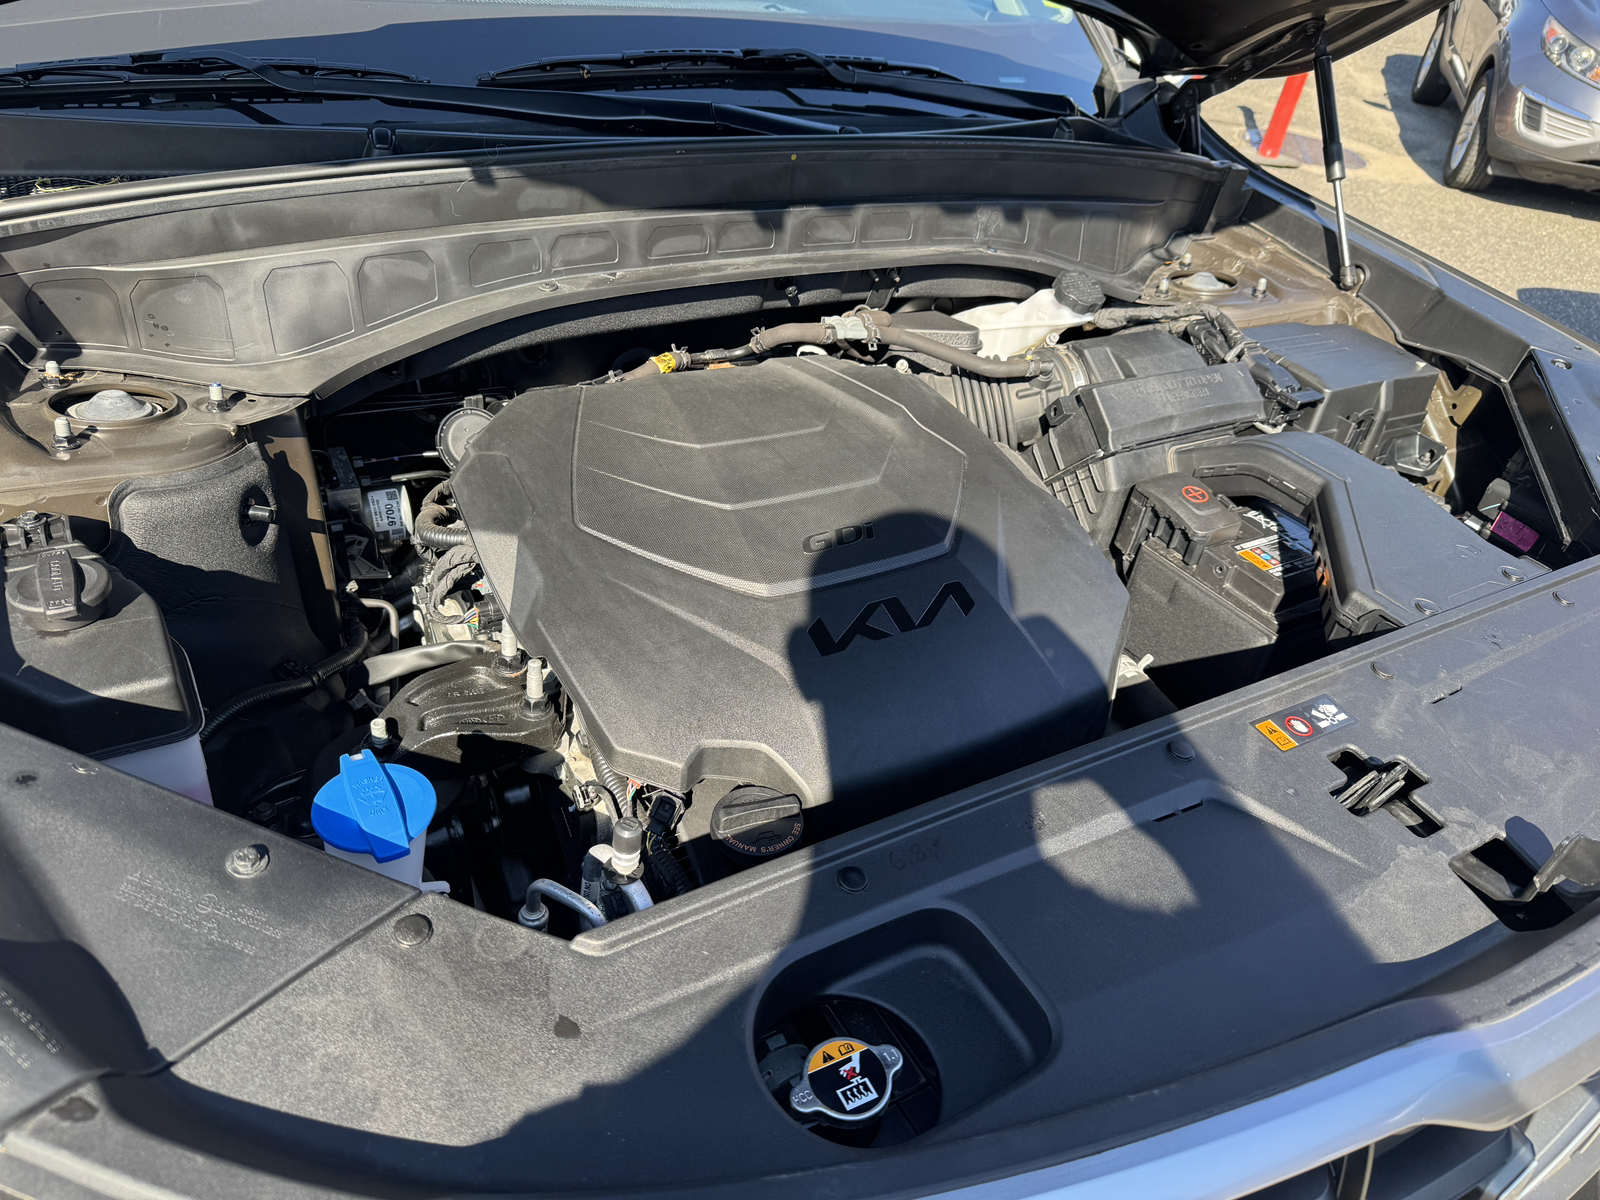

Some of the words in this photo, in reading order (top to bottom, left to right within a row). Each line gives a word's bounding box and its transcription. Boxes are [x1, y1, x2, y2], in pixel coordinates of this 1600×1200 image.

[384, 503, 397, 527] 9700
[807, 579, 975, 657] KIA
[792, 822, 802, 836] SEE
[726, 834, 756, 852] MANUAL
[760, 836, 794, 852] OWNER'S
[883, 1048, 899, 1062] 1.1
